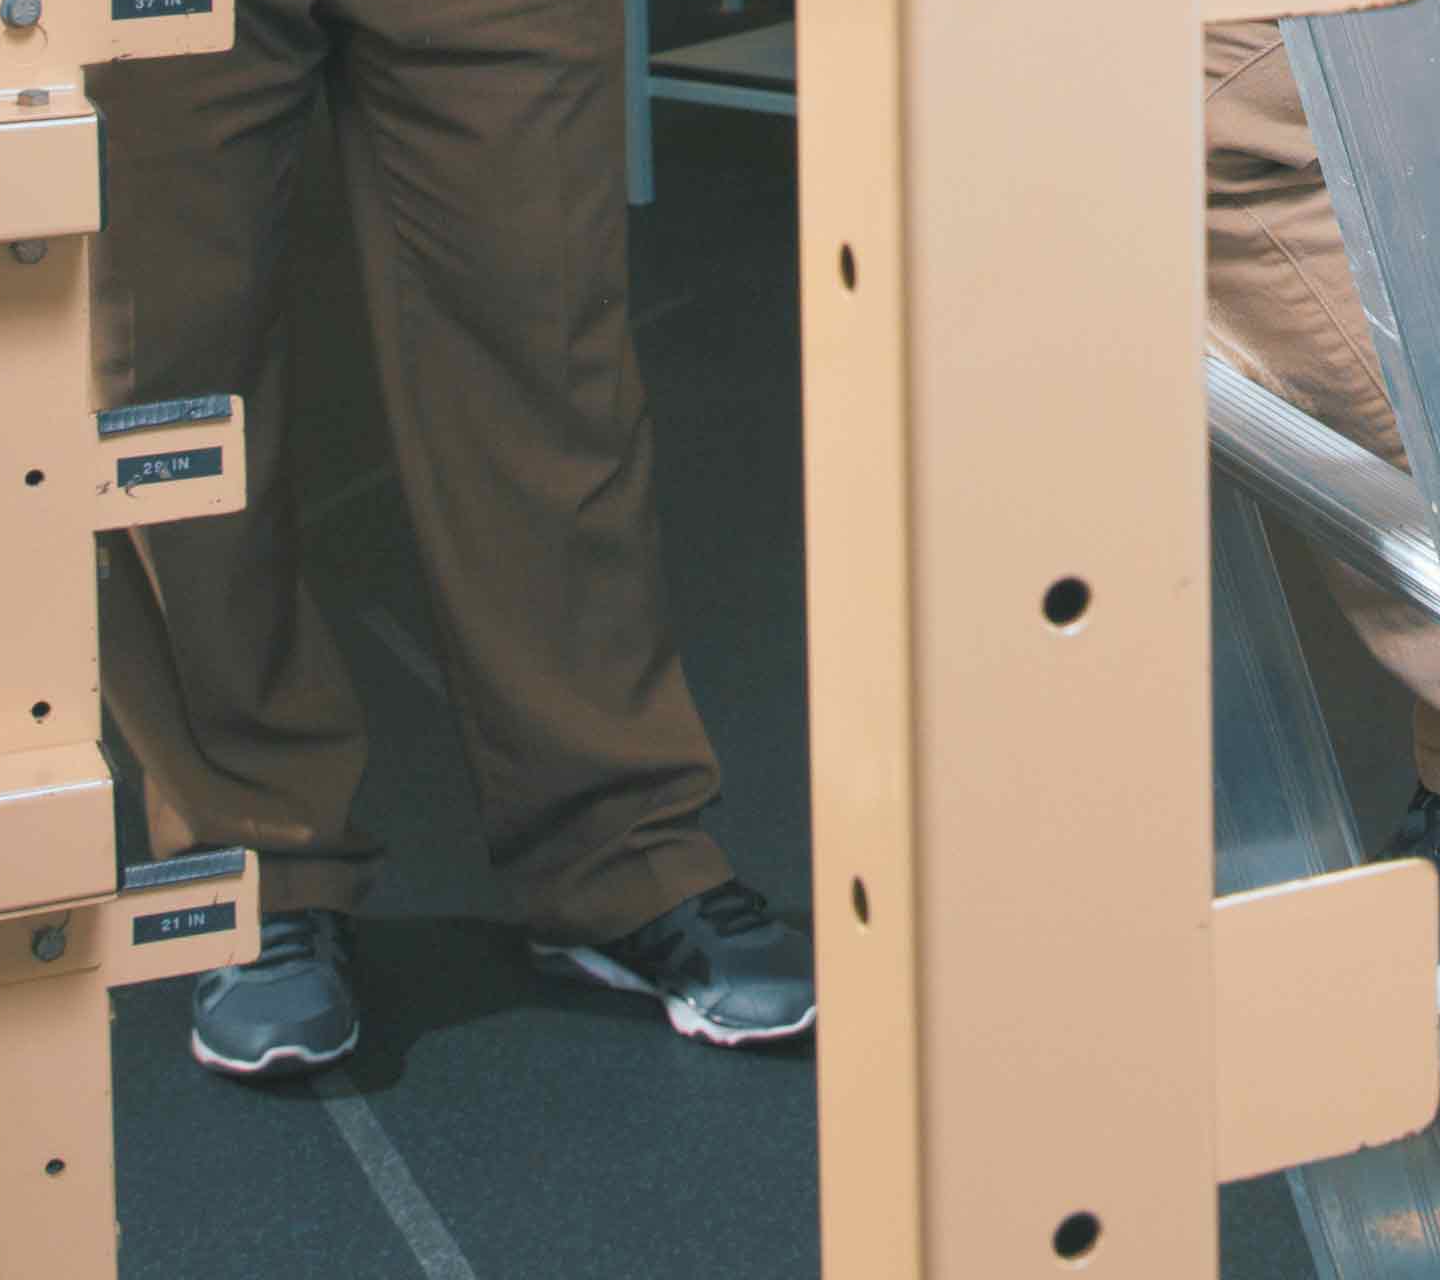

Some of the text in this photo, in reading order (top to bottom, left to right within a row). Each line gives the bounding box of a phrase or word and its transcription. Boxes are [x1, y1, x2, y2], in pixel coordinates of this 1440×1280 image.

[171, 456, 190, 472] IN
[160, 912, 206, 932] 21 IN
